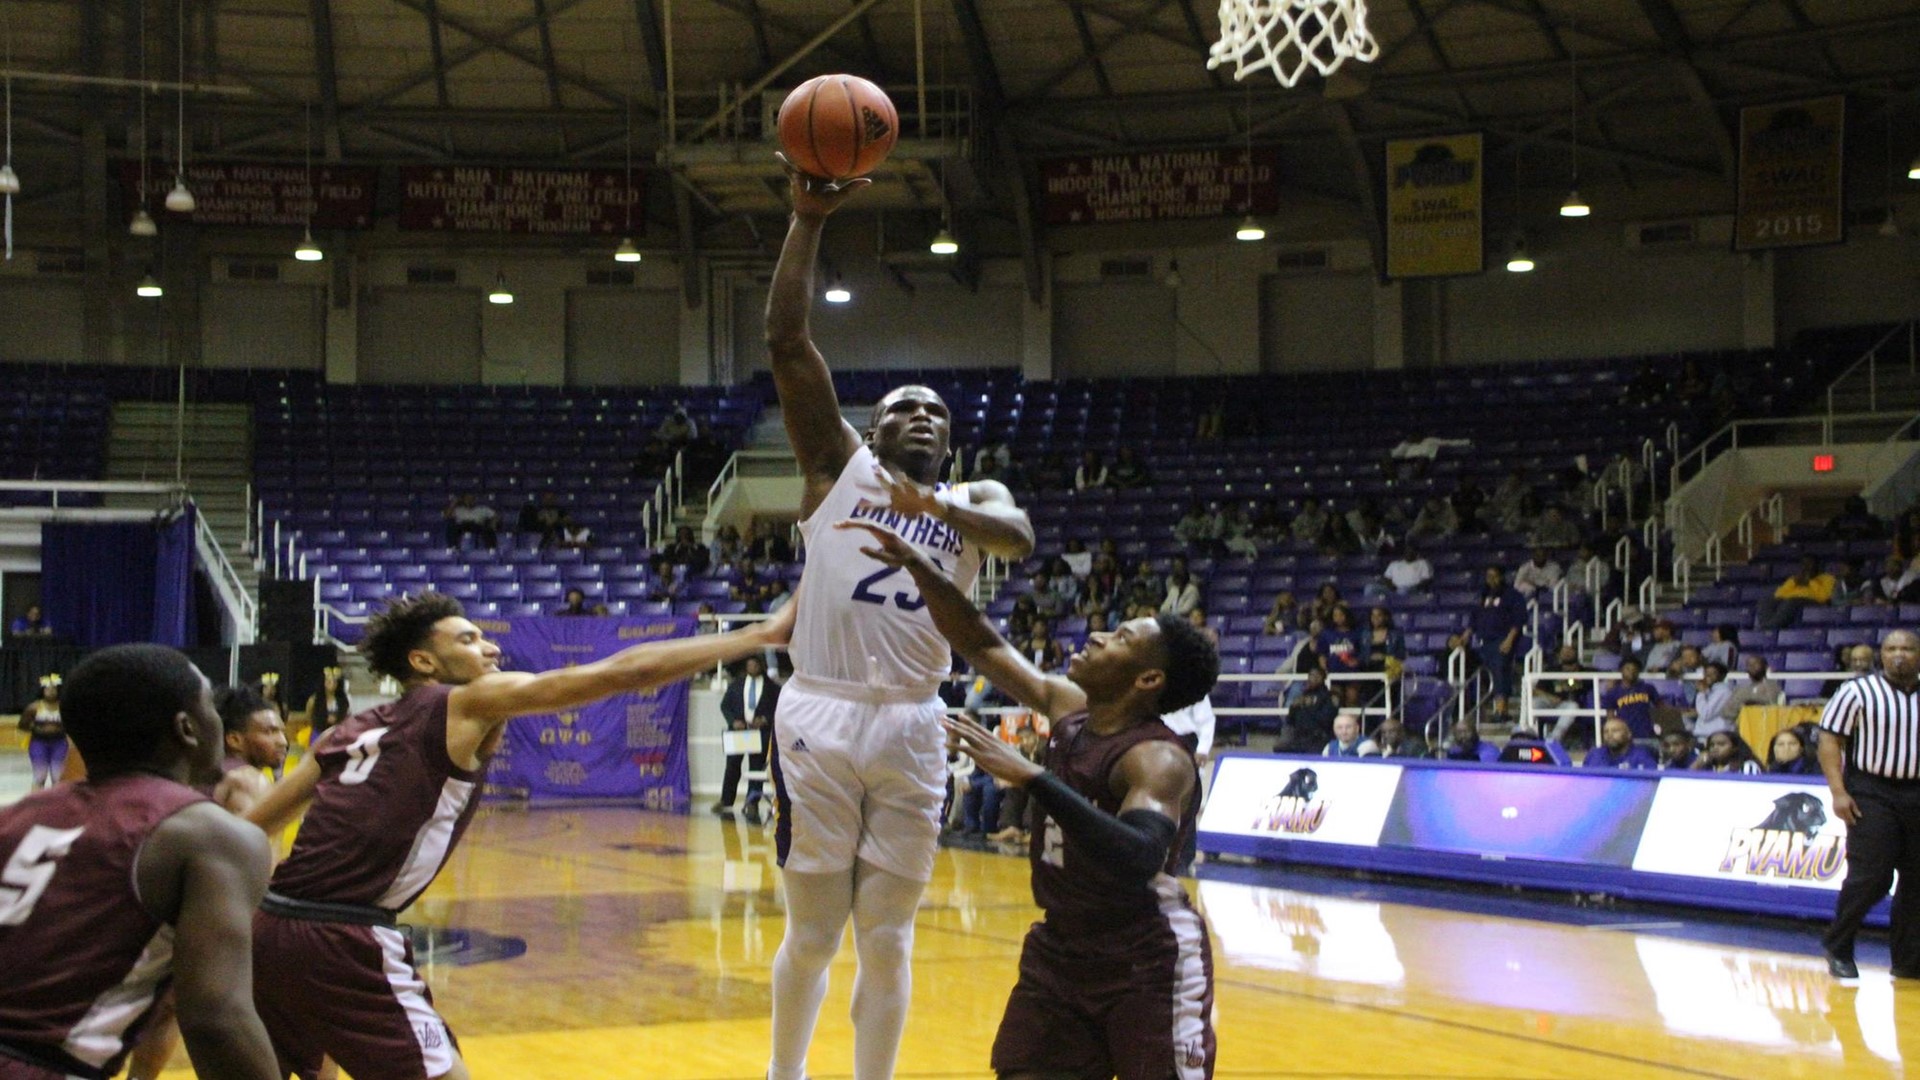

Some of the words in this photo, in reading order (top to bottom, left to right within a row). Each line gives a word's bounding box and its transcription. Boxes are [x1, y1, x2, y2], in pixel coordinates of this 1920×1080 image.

[1092, 156, 1131, 174] NAIA
[1139, 150, 1219, 171] NATIONAL
[231, 167, 307, 182] NATIONAL
[454, 167, 492, 185] NAIA
[512, 169, 589, 188] NATIONAL
[1048, 174, 1109, 194] INDOOR
[1119, 169, 1171, 189] TRACK
[1182, 167, 1216, 185] AND
[1223, 163, 1270, 184] FIELD
[223, 182, 273, 198] TRACK
[320, 184, 363, 201] FIELD
[407, 181, 486, 200] OUTDOOR
[494, 185, 549, 204] TRACK
[554, 188, 589, 205] AND
[594, 188, 639, 206] FIELD
[1086, 187, 1186, 208] CHAMPIONS
[445, 199, 545, 220] CHAMPIONS
[1410, 196, 1460, 212] SWAC
[1718, 827, 1847, 882] PVAMU
